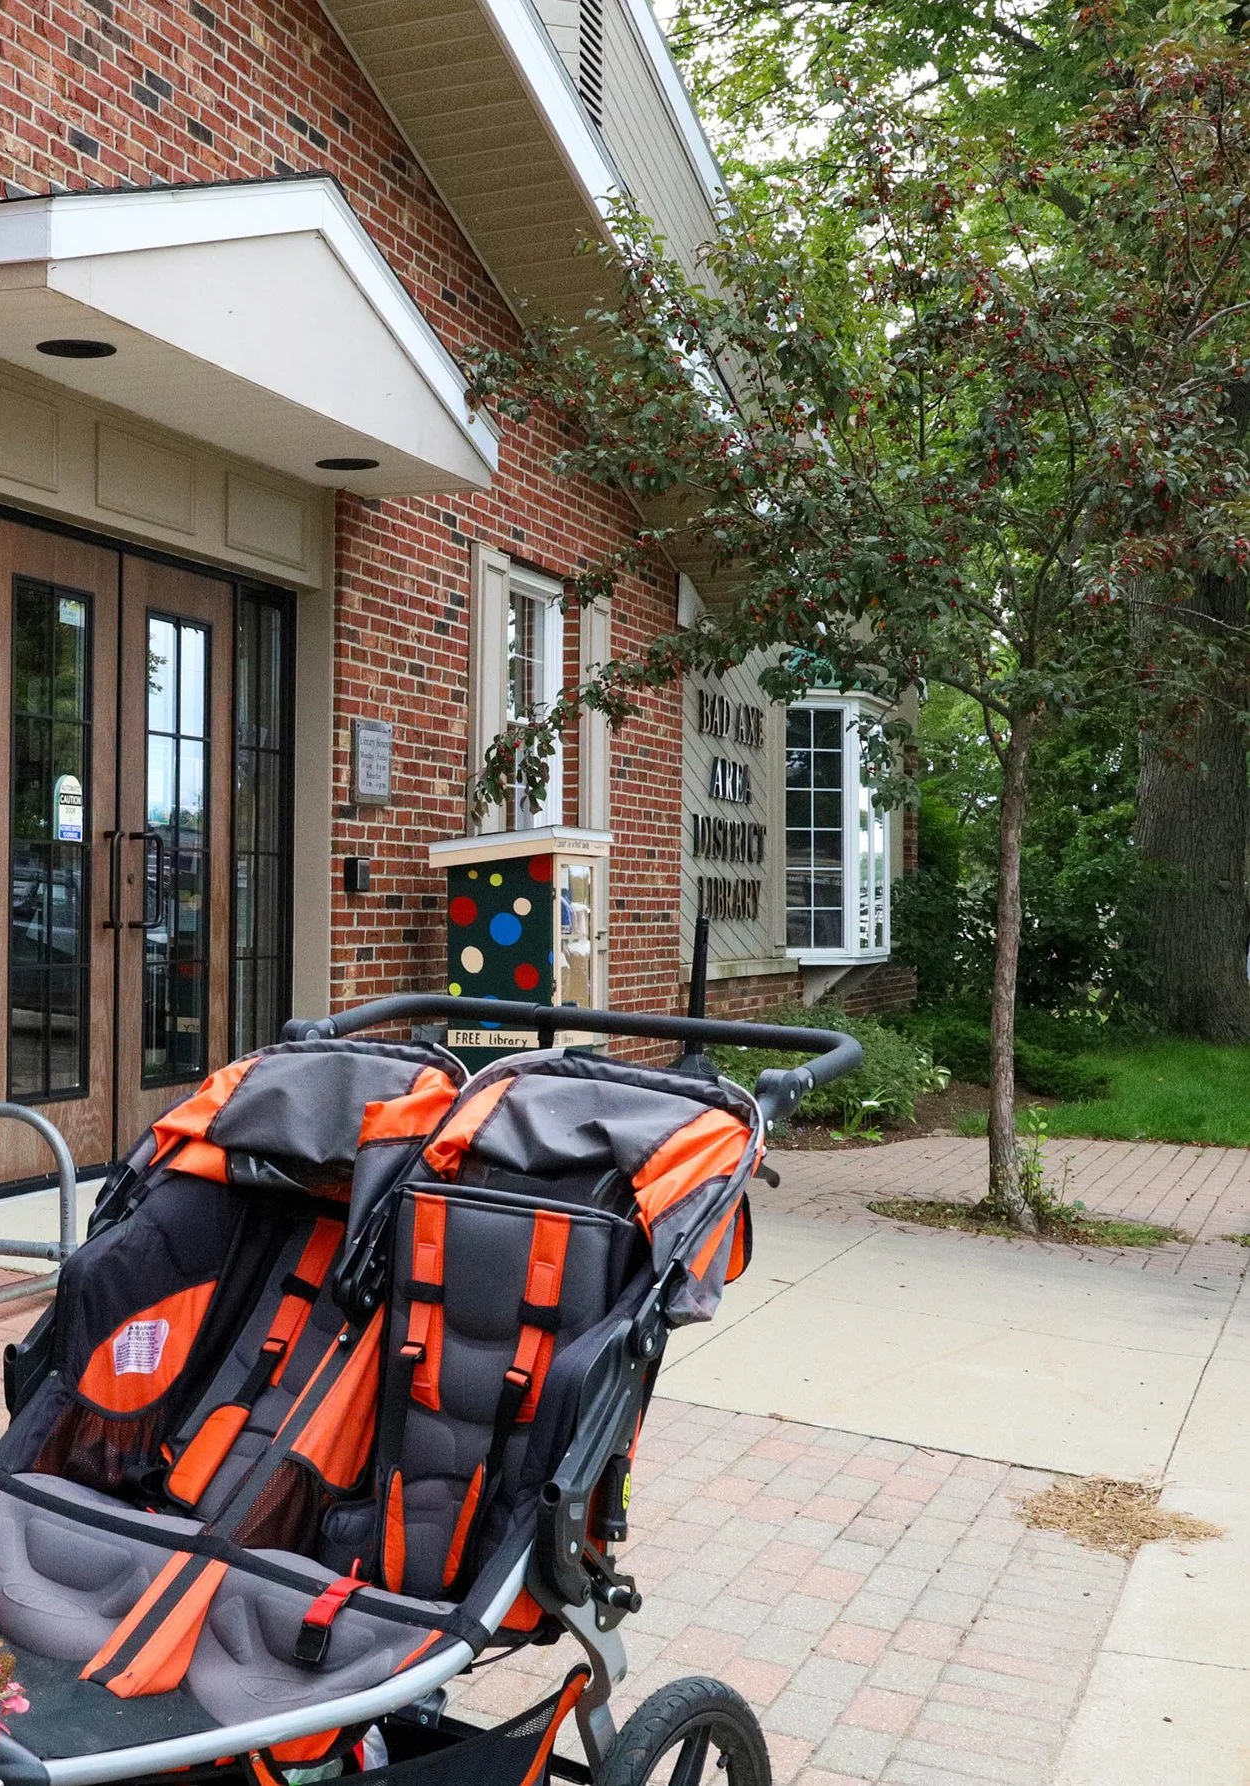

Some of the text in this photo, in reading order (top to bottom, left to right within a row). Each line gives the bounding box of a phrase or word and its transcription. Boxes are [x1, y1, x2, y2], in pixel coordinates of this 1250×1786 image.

[698, 689, 764, 749] BAD AXE
[60, 794, 82, 805] CAUTION
[709, 756, 752, 806] AREA
[692, 814, 767, 864] DISTRICT
[697, 875, 761, 921] LIBRARY
[455, 1031, 528, 1048] FREE Library
